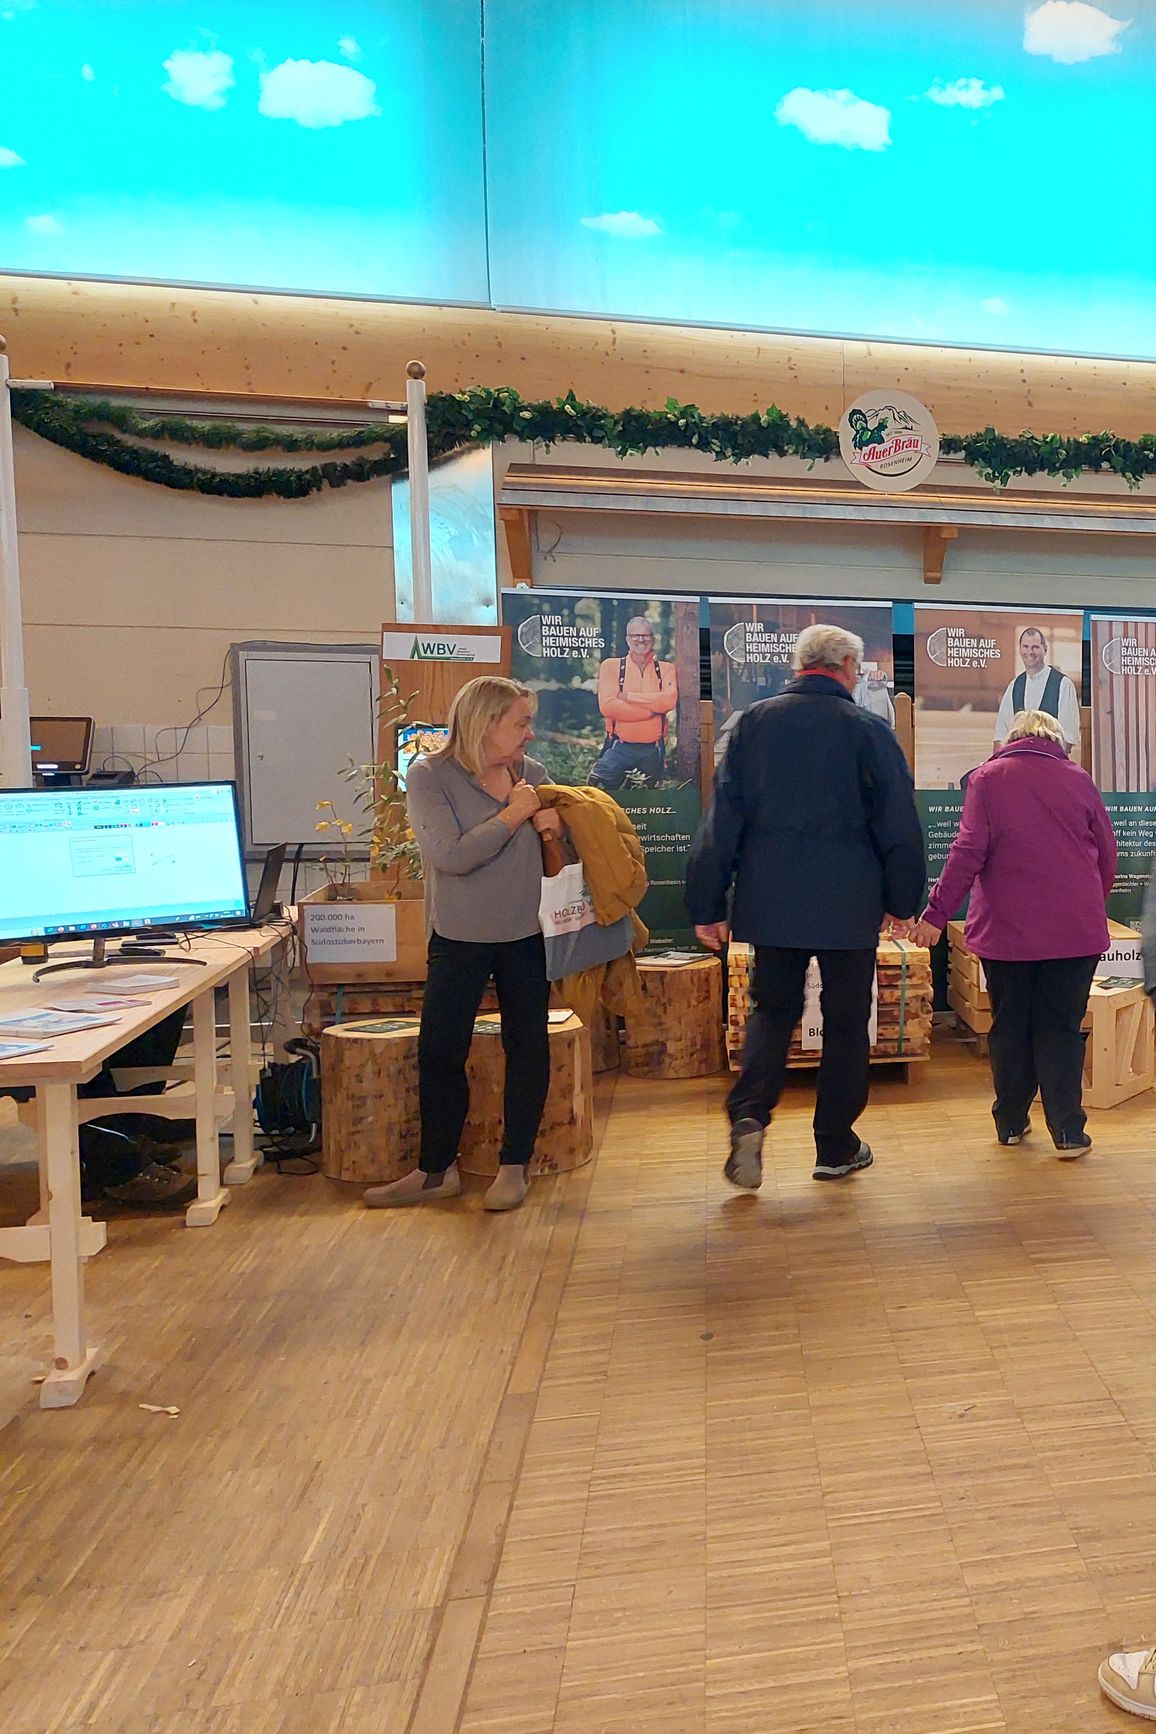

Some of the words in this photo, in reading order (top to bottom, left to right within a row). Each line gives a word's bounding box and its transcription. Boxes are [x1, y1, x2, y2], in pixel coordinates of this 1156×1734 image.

[863, 437, 919, 461] AuerBräu
[879, 457, 913, 469] ROSENHEIM
[541, 615, 562, 625] WIR
[542, 626, 577, 636] BAUEN
[579, 627, 600, 637] AUF
[745, 622, 764, 632] WIR
[746, 633, 777, 642] BAUEN
[780, 634, 799, 642] AUF
[947, 628, 965, 637] WIR
[542, 637, 605, 648] HEIMISCHES
[948, 638, 977, 647] BAUEN
[979, 639, 997, 648] AUF
[1121, 638, 1137, 646] WIR
[421, 643, 457, 655] WBV
[543, 648, 570, 657] HOLZ
[572, 649, 590, 658] e.V.
[746, 643, 797, 653] HEIMISCHE
[948, 648, 1001, 658] HEIMISCHES
[1122, 647, 1149, 656] BAUEN
[747, 654, 771, 663] HOLZ
[773, 654, 789, 663] e.V.
[948, 658, 970, 667] HOLZ
[972, 659, 987, 668] e.V.
[1122, 666, 1142, 674] HOLZ
[633, 823, 647, 831] seit
[640, 833, 691, 841] wirtschaften
[1138, 830, 1153, 838] Weg
[1117, 839, 1142, 847] hitektur
[310, 913, 343, 921] 200.000
[344, 913, 355, 921] ha
[311, 938, 385, 946] Südostoberbayern
[1100, 949, 1142, 962] auholz
